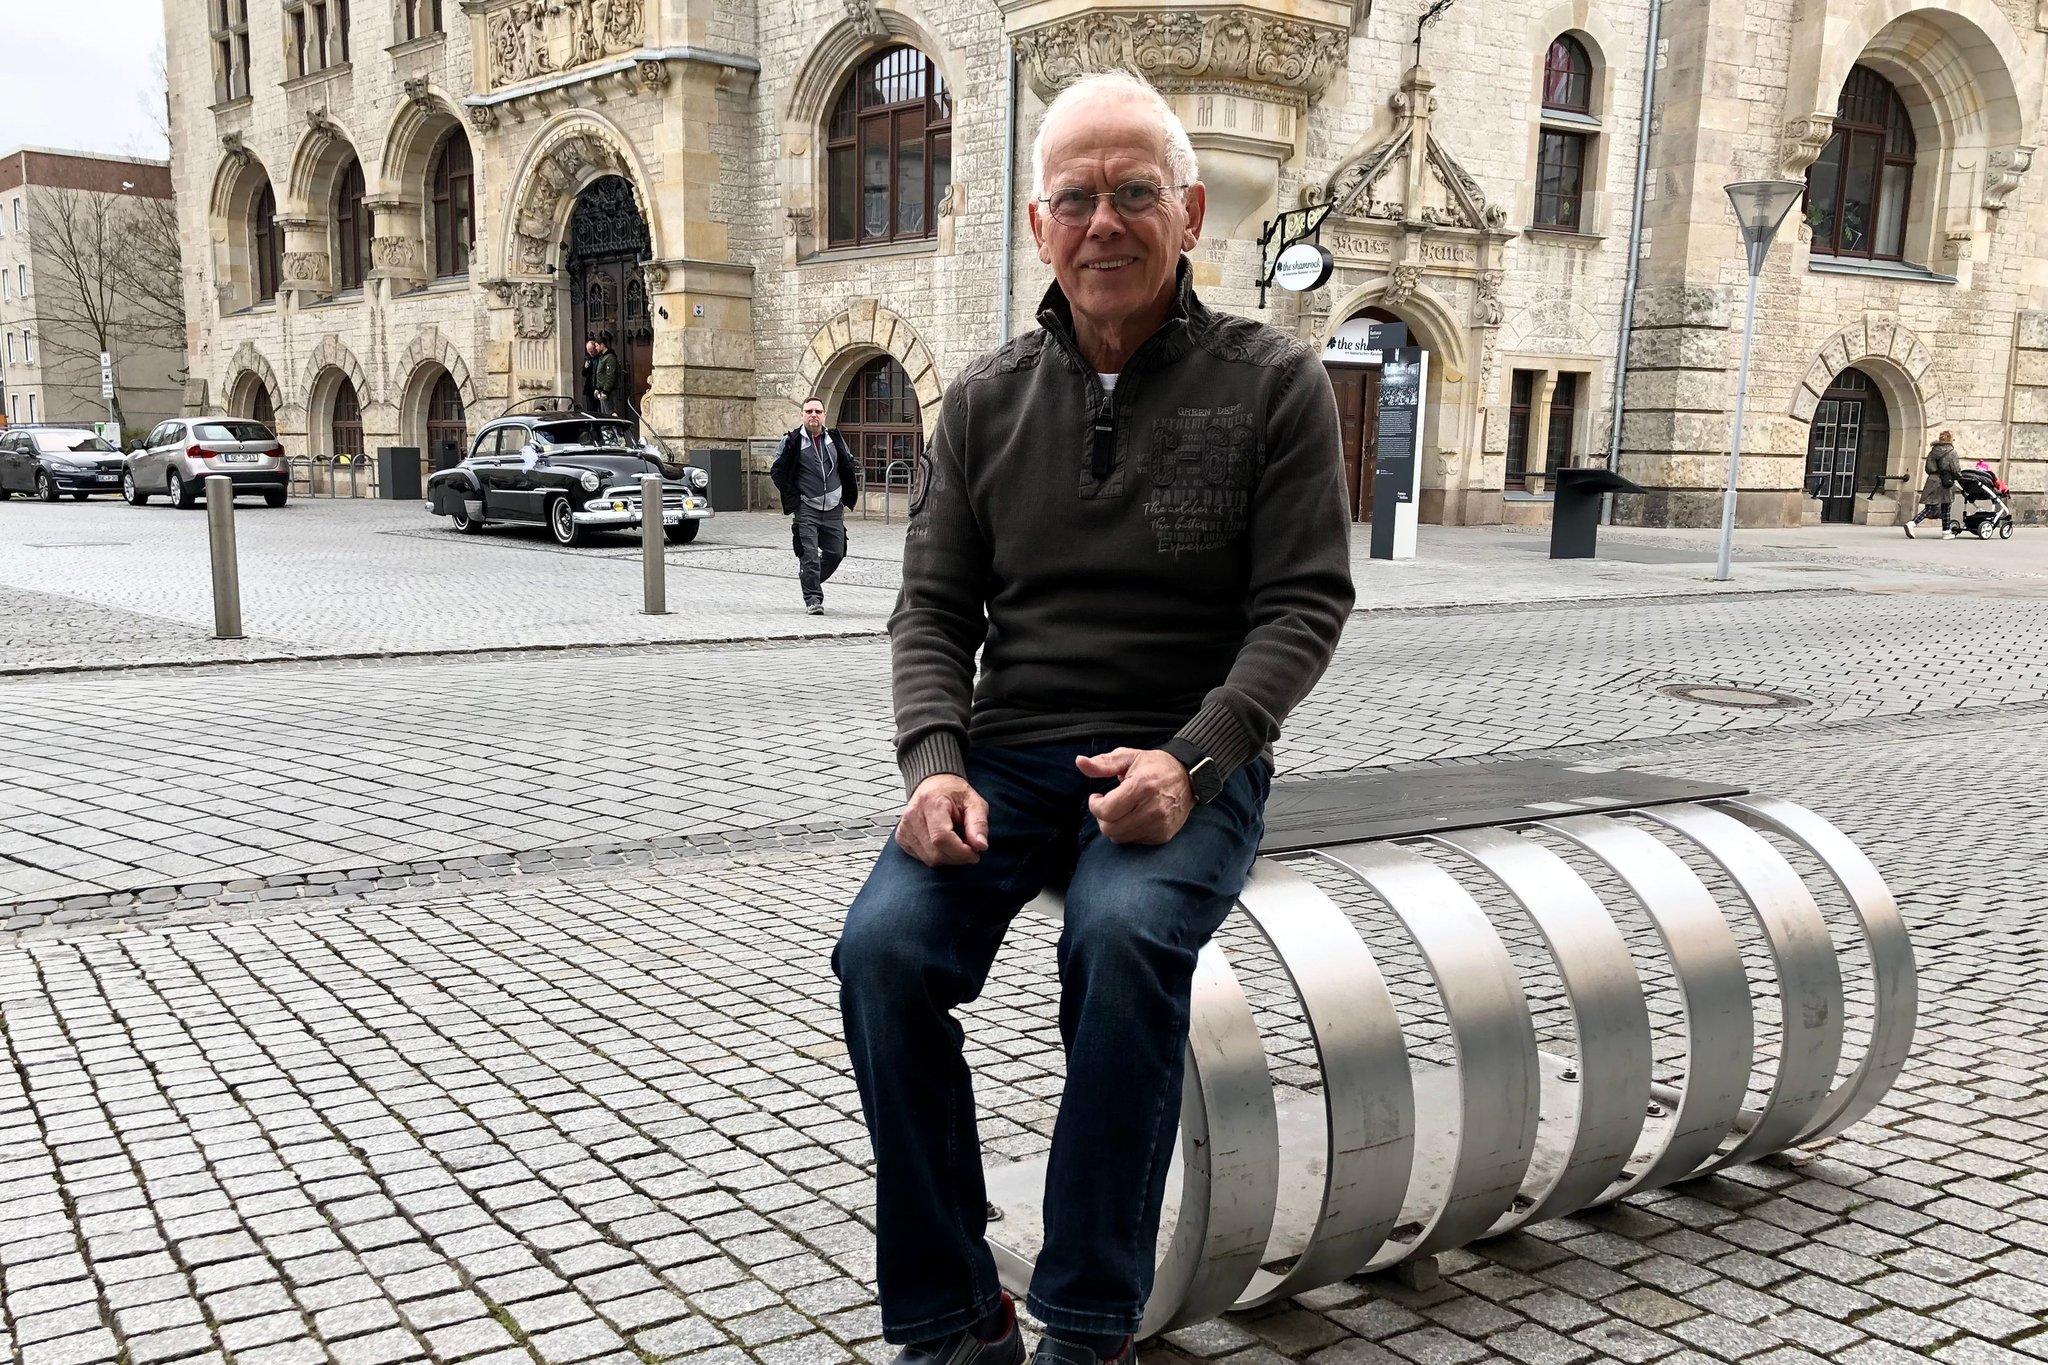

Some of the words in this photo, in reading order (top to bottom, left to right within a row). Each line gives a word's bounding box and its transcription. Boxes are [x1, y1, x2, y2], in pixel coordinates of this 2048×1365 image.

[1283, 261, 1291, 271] the
[1292, 257, 1320, 270] shamrock
[1337, 336, 1352, 350] the
[1178, 407, 1211, 417] GREEN
